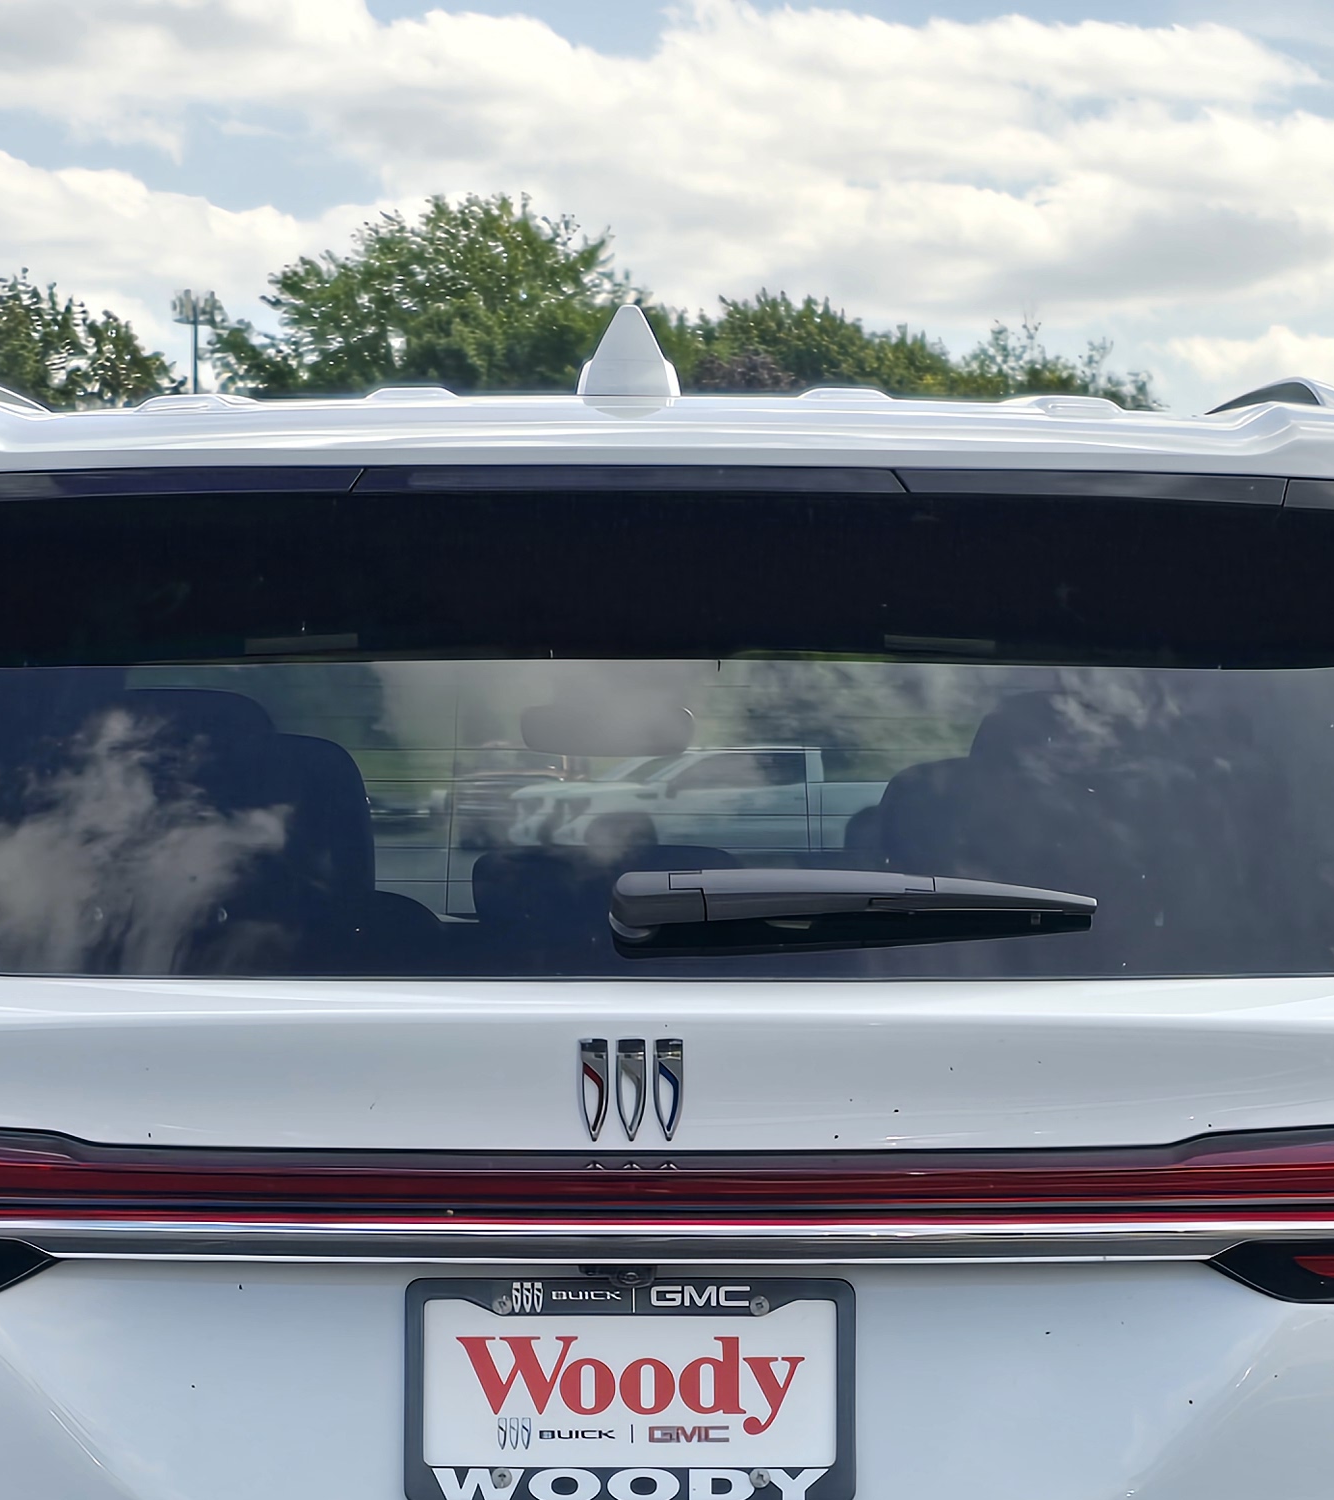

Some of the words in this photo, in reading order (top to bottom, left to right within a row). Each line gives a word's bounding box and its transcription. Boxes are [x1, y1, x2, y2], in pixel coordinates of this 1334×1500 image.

[551, 1290, 622, 1300] BUICK
[650, 1285, 751, 1307] GMC
[455, 1336, 805, 1435] Woody
[538, 1429, 616, 1440] BUICK
[648, 1425, 730, 1443] GMC
